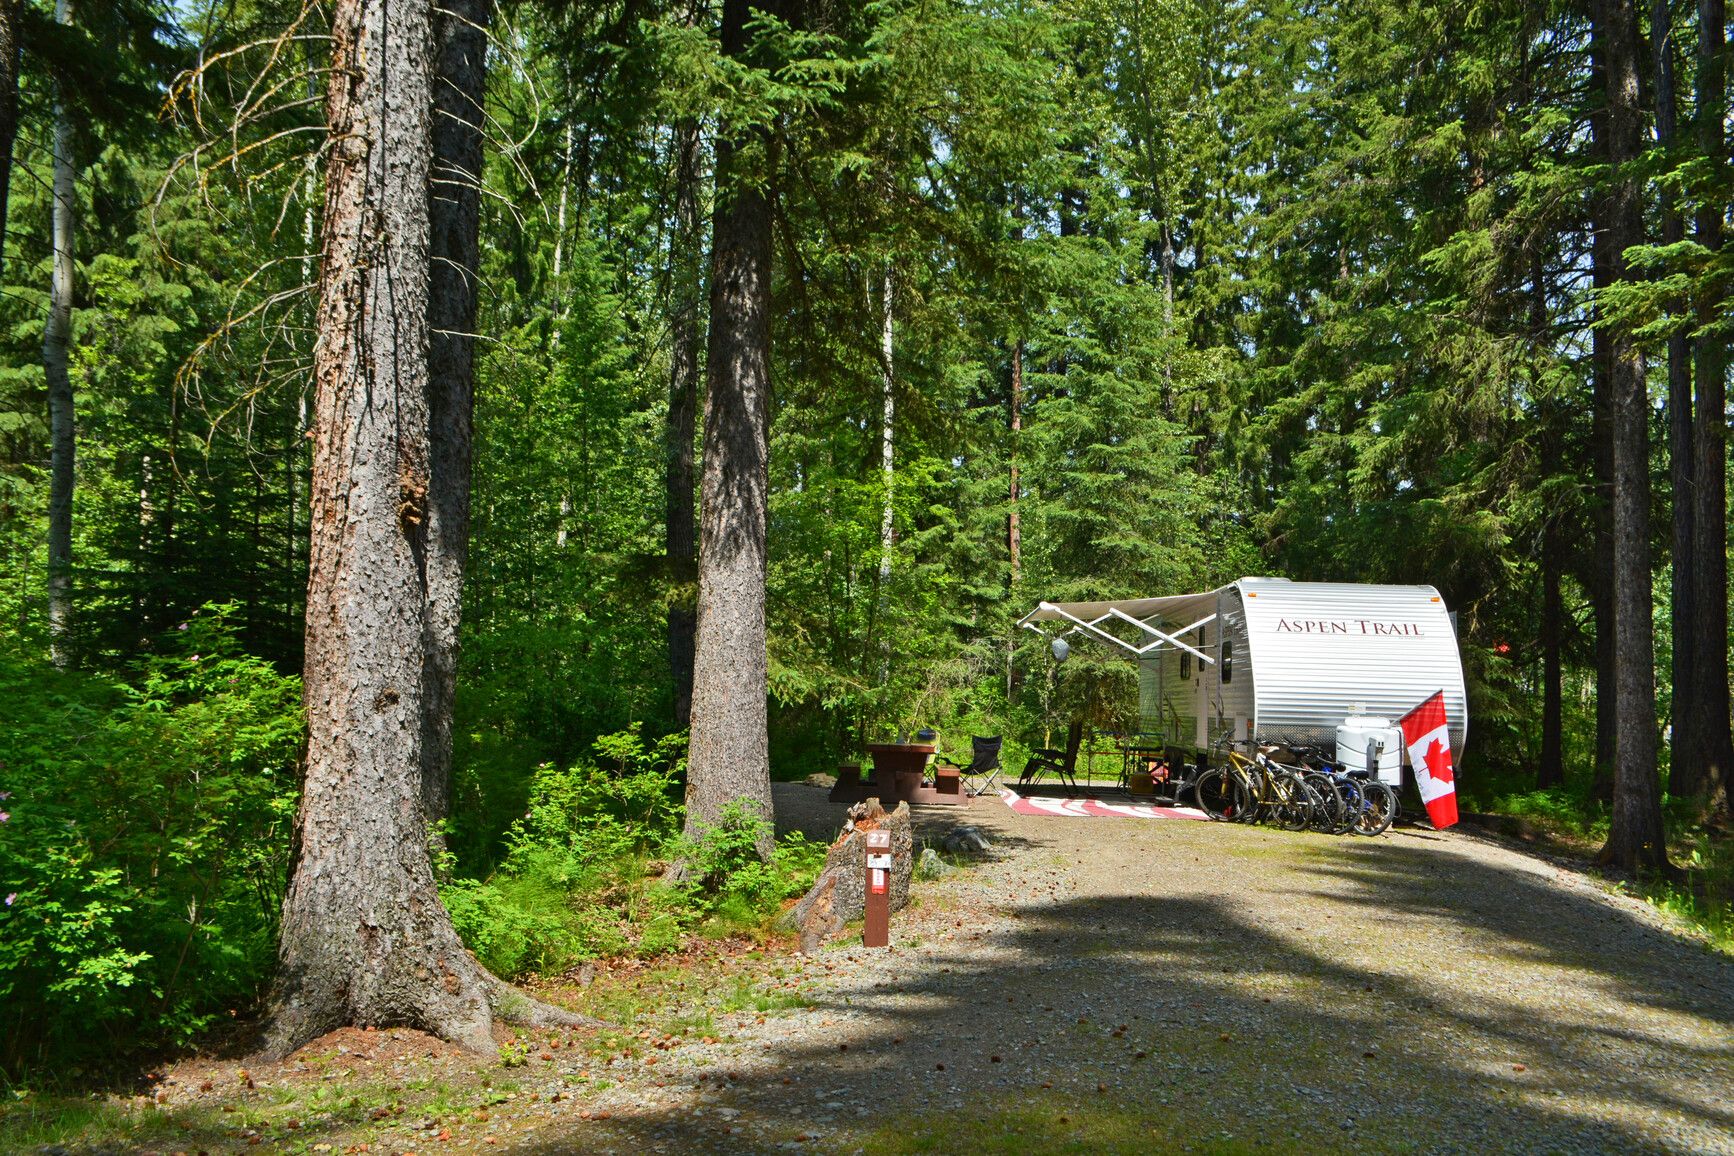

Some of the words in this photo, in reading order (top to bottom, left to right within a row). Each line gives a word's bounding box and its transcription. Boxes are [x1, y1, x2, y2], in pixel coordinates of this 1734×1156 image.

[1276, 618, 1347, 634] ASPEN
[1354, 619, 1425, 636] TRAIL
[869, 833, 887, 843] 27
